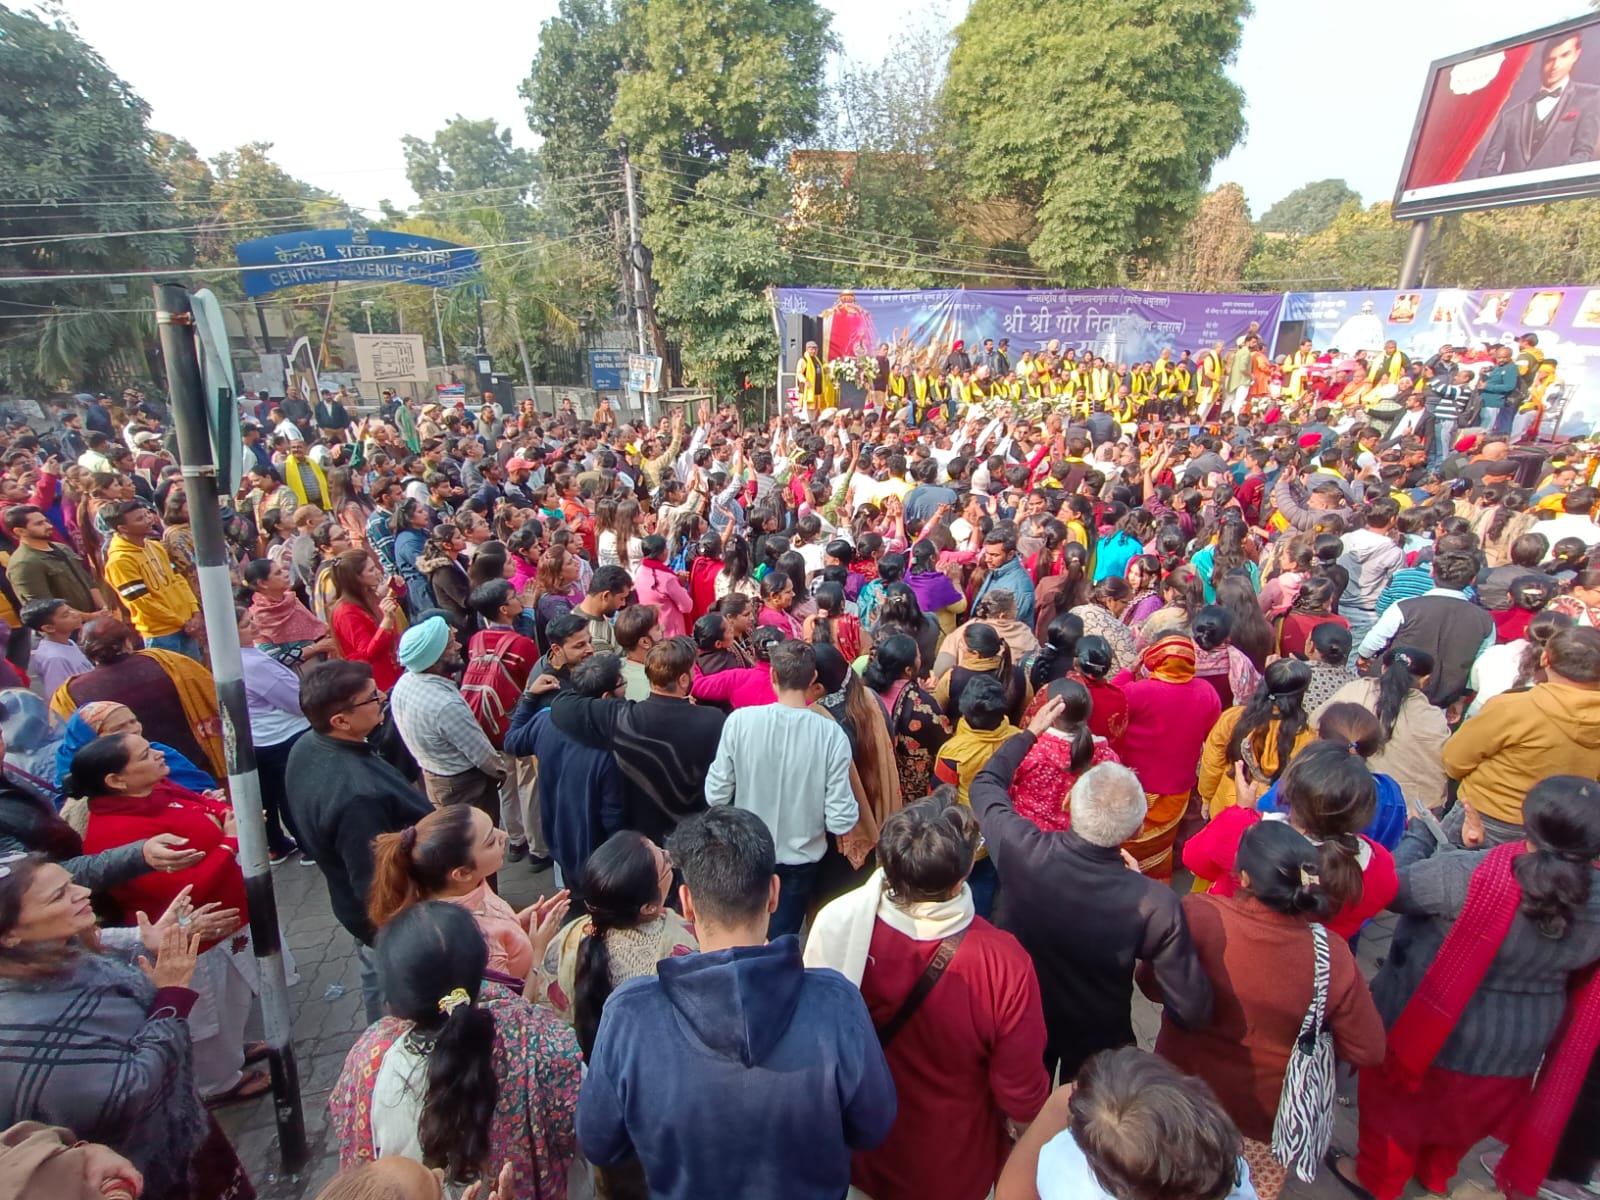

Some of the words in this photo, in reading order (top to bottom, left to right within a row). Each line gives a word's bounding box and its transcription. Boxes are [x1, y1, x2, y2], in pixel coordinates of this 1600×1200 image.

[275, 242, 326, 263] केन्द्रीय
[335, 244, 387, 259] राजस्व
[269, 266, 337, 287] CENTRAL
[338, 263, 404, 278] REVENUE
[1003, 305, 1026, 334] श्री
[1029, 306, 1052, 334] श्री
[1056, 306, 1082, 334] गौर
